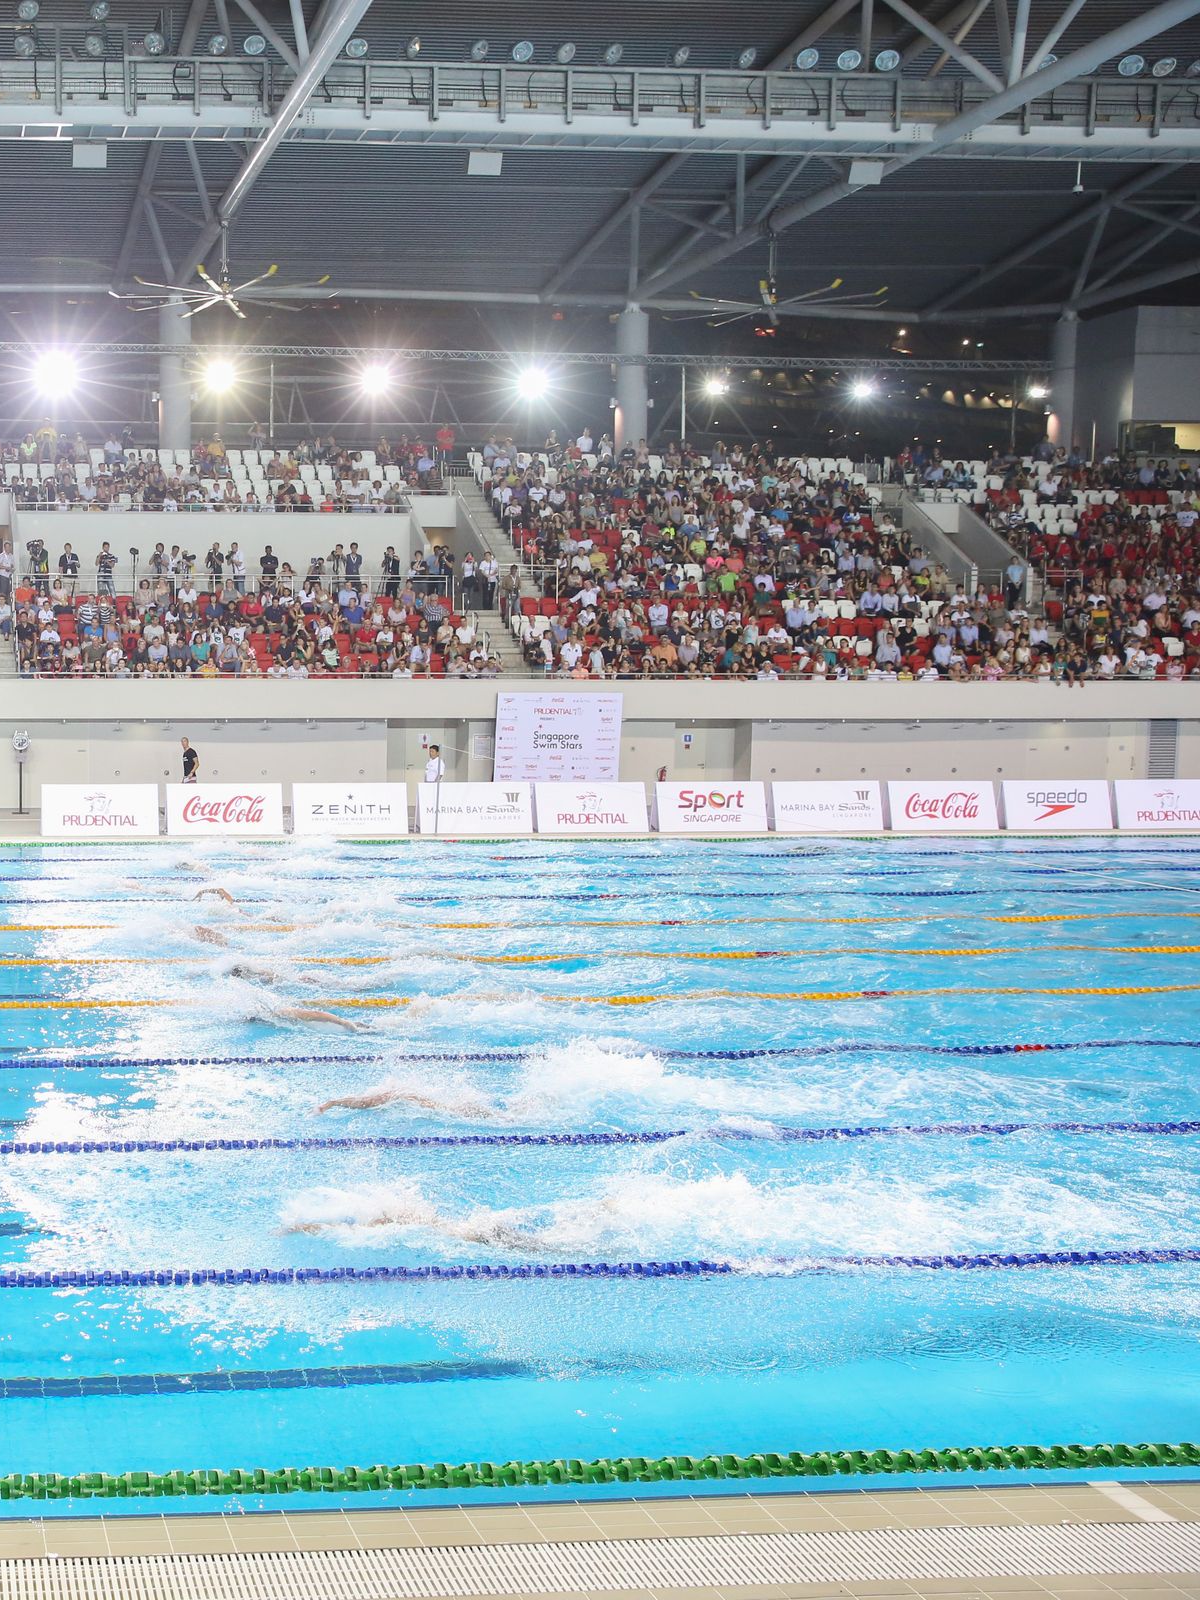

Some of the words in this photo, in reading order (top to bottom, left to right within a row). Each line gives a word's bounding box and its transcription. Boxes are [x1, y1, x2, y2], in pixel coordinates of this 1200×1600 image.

[533, 707, 573, 715] PRUDENTIAL
[533, 730, 580, 743] Singapore
[533, 740, 558, 749] Swim
[560, 740, 583, 750] Stars
[678, 790, 744, 812] Sport
[1026, 789, 1088, 807] speedo
[182, 795, 266, 823] Coca-Cola
[311, 804, 391, 815] ZENITH
[426, 806, 464, 814] MARINA
[466, 806, 484, 814] BAY
[780, 804, 816, 812] MARINA
[818, 804, 835, 812] BAY
[904, 792, 980, 819] Coca-Cola
[62, 814, 138, 826] PRUDENTIAL
[557, 813, 629, 825] PRUDENTIAL
[683, 814, 742, 822] SINGAPORE
[1137, 810, 1200, 822] PRUDENTIA
